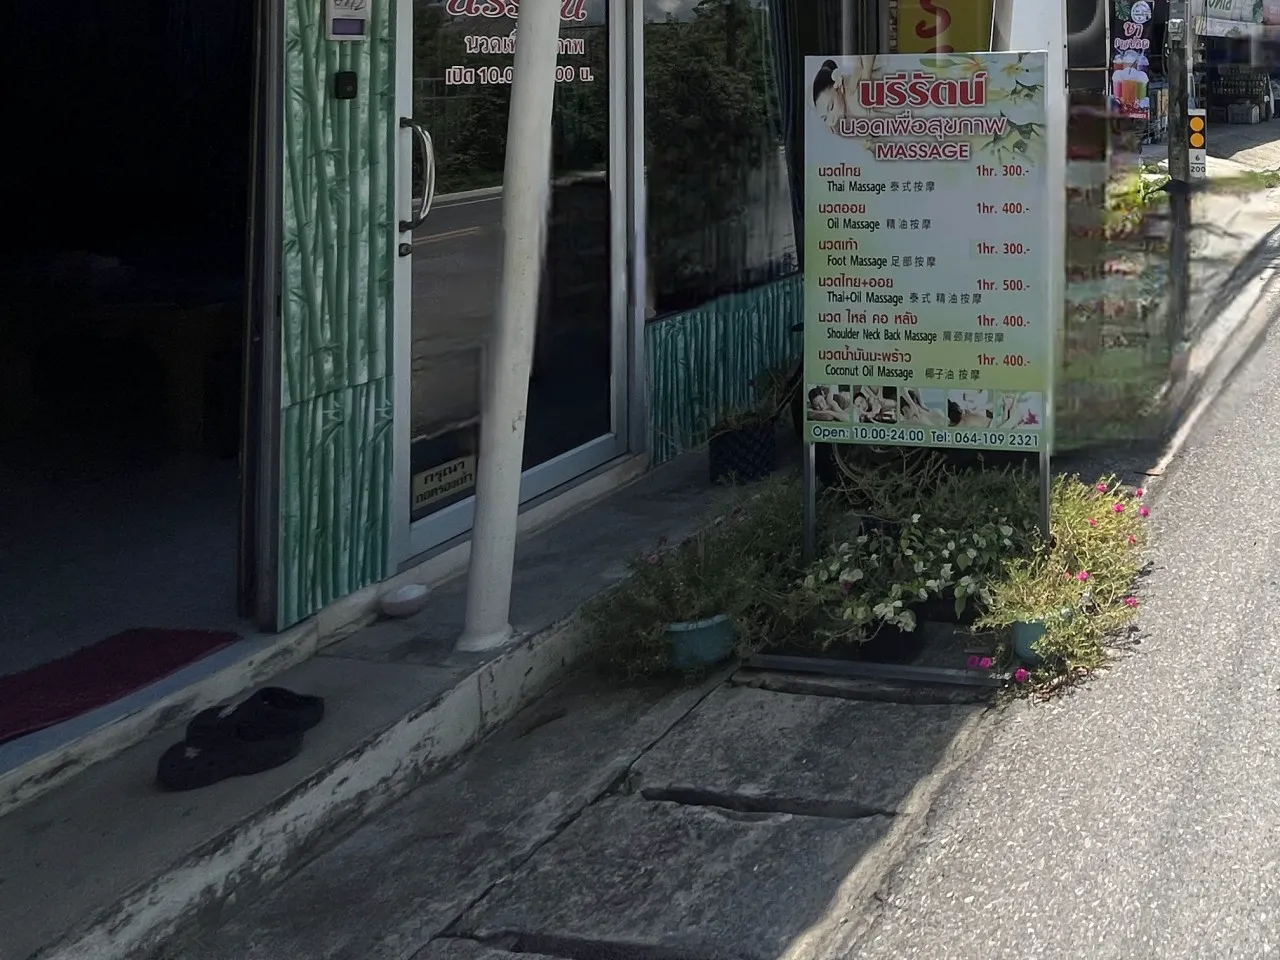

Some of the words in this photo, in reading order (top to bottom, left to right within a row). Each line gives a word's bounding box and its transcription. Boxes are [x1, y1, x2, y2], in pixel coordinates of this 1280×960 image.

[446, 66, 475, 84] เปิด
[860, 73, 987, 107] นรีรัตน์
[840, 109, 1007, 141] นวดเพื่อสุขภาพ
[876, 143, 969, 159] MASSAGE
[818, 162, 861, 177] นวดไทย
[976, 165, 998, 177] 1hr.
[1002, 165, 1030, 177] 300.-
[827, 180, 845, 192] Thai
[849, 181, 886, 195] Massage
[890, 181, 935, 193] 泰式按摩
[818, 203, 866, 214] นวดออย
[976, 202, 998, 214] 1hr.
[1002, 202, 1030, 214] 400.-
[827, 218, 840, 230] Oil
[843, 218, 880, 232] Massage
[818, 237, 858, 251] นวดเท้า
[976, 242, 998, 255] 1hr.
[1002, 242, 1030, 255] 300.-
[827, 254, 847, 267] Foot
[850, 255, 887, 270] Massage
[890, 256, 936, 268] 足部按摩
[818, 273, 893, 288] นวดไทย+ออย
[976, 279, 998, 291] 1hr.
[1002, 279, 1030, 291] 500.-
[827, 291, 862, 303] Thai+Oil
[866, 292, 904, 307] Massage
[818, 311, 841, 323] นวด
[847, 309, 867, 324] ไหล่
[872, 313, 888, 324] คอ
[894, 311, 918, 325] หลัง
[976, 314, 998, 327] 1hr.
[1002, 314, 1030, 327] 400.-
[827, 328, 860, 340] Shoulder
[863, 329, 881, 340] Neck
[884, 329, 901, 341] Back
[905, 329, 937, 344] Massage
[976, 354, 998, 366] 1hr.
[1002, 354, 1030, 366] 400.-
[825, 364, 859, 377] Coconut
[863, 365, 874, 378] Oil
[877, 365, 914, 381] Massage
[813, 426, 849, 438] Open:
[853, 427, 924, 442] 10.00-24.00
[931, 431, 951, 442] Tel:
[954, 432, 1005, 444] 064-109
[1009, 433, 1039, 446] 2321
